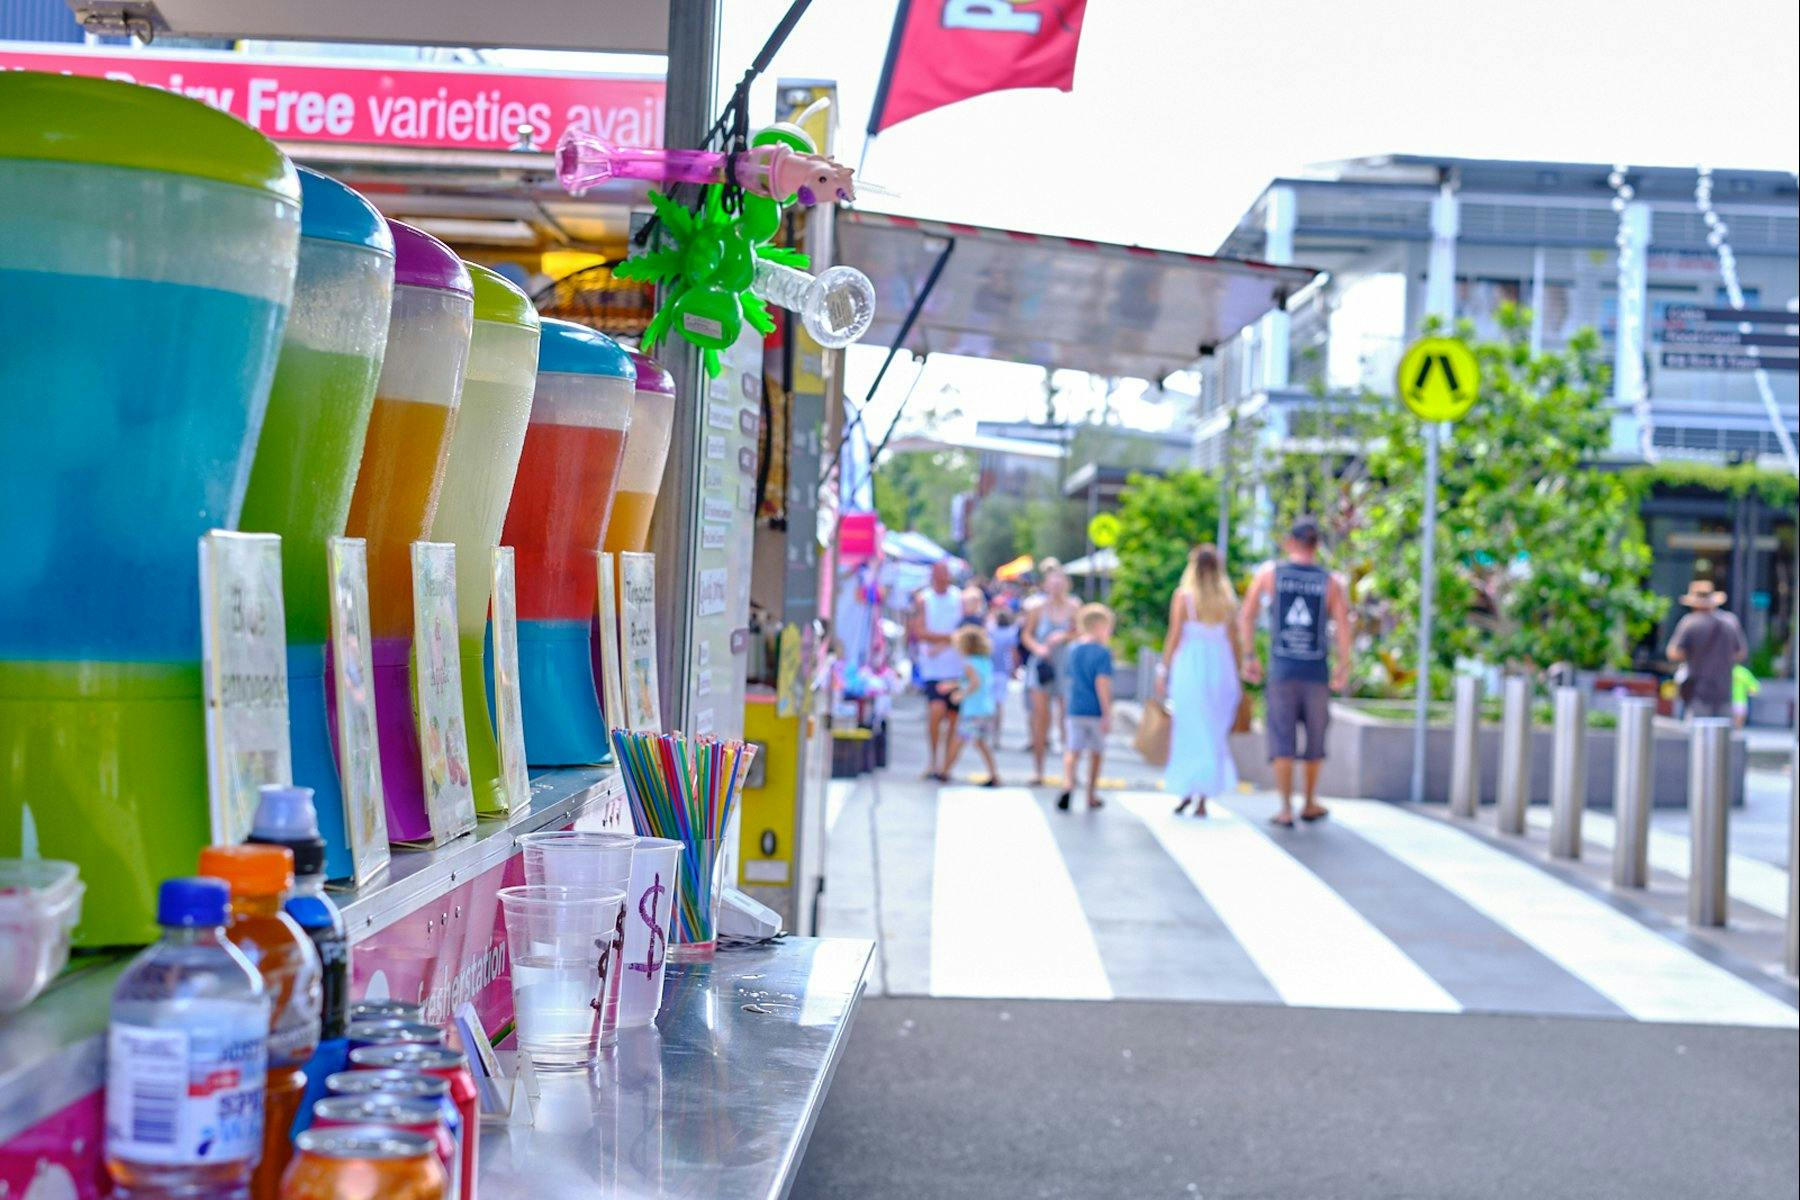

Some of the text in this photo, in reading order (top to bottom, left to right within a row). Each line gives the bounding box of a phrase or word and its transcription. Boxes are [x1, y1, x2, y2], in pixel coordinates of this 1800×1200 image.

[247, 78, 354, 136] Free
[367, 88, 552, 146] varieties
[628, 872, 665, 980] $
